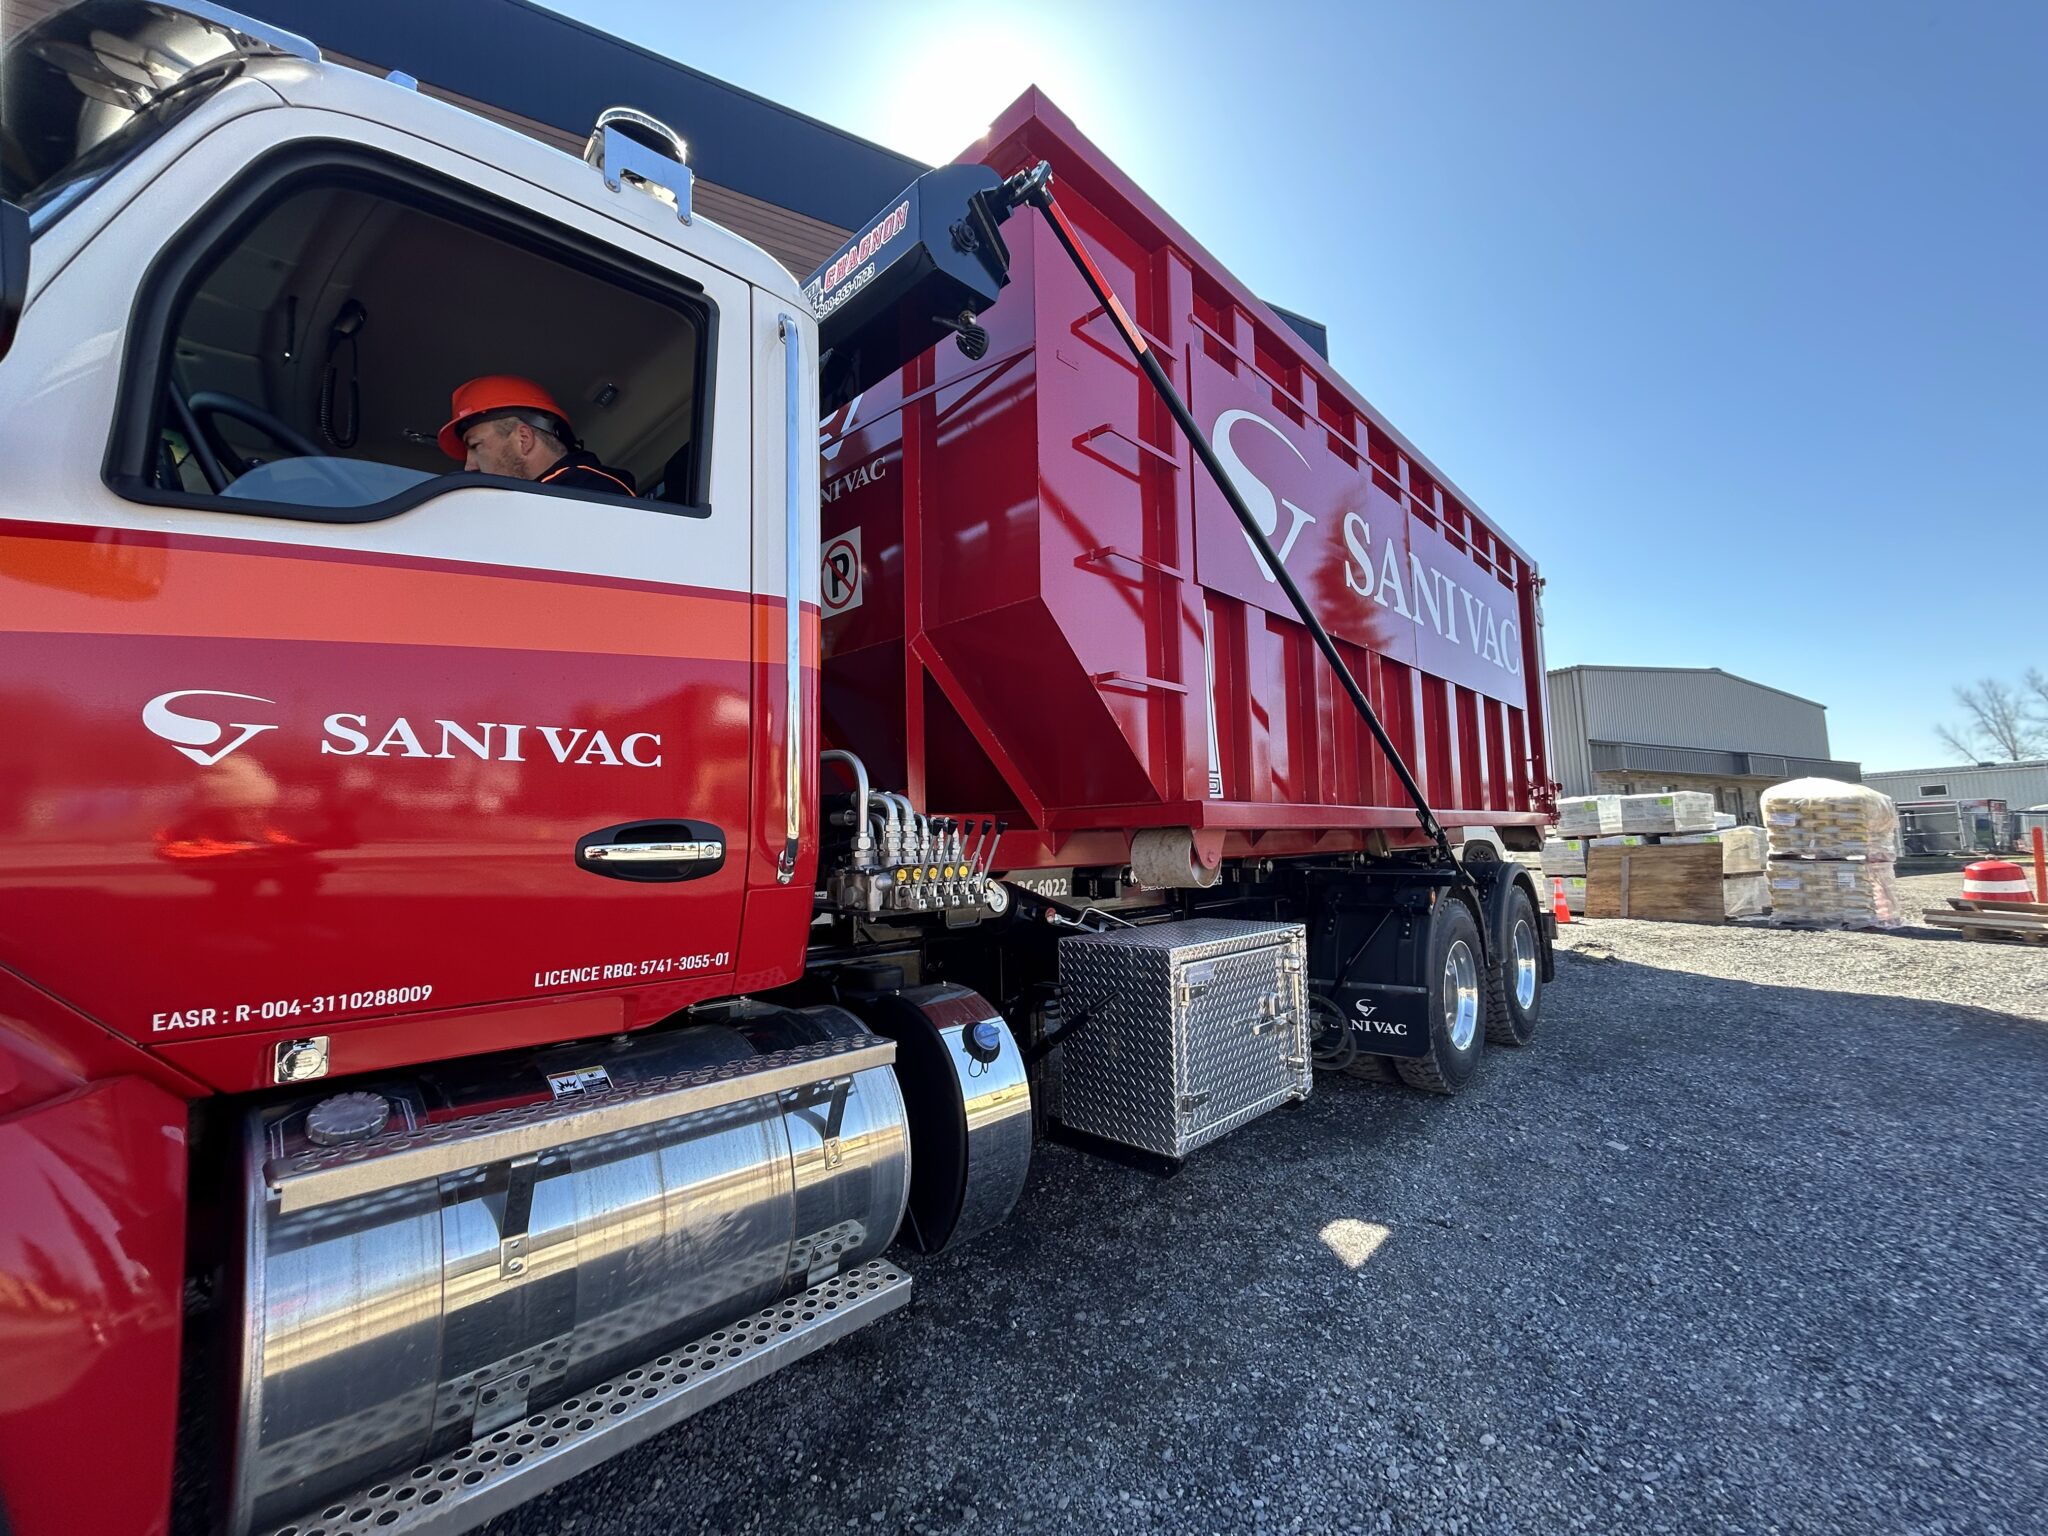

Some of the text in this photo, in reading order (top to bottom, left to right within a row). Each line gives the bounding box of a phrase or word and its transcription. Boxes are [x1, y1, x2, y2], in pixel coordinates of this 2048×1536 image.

[824, 200, 909, 294] CHAGNON
[816, 262, 875, 319] -800-565-1723
[534, 952, 730, 988] LICENCE RBQ: 5741-3055-01
[152, 1008, 216, 1032] EASR
[235, 984, 433, 1022] R-004-3110288009
